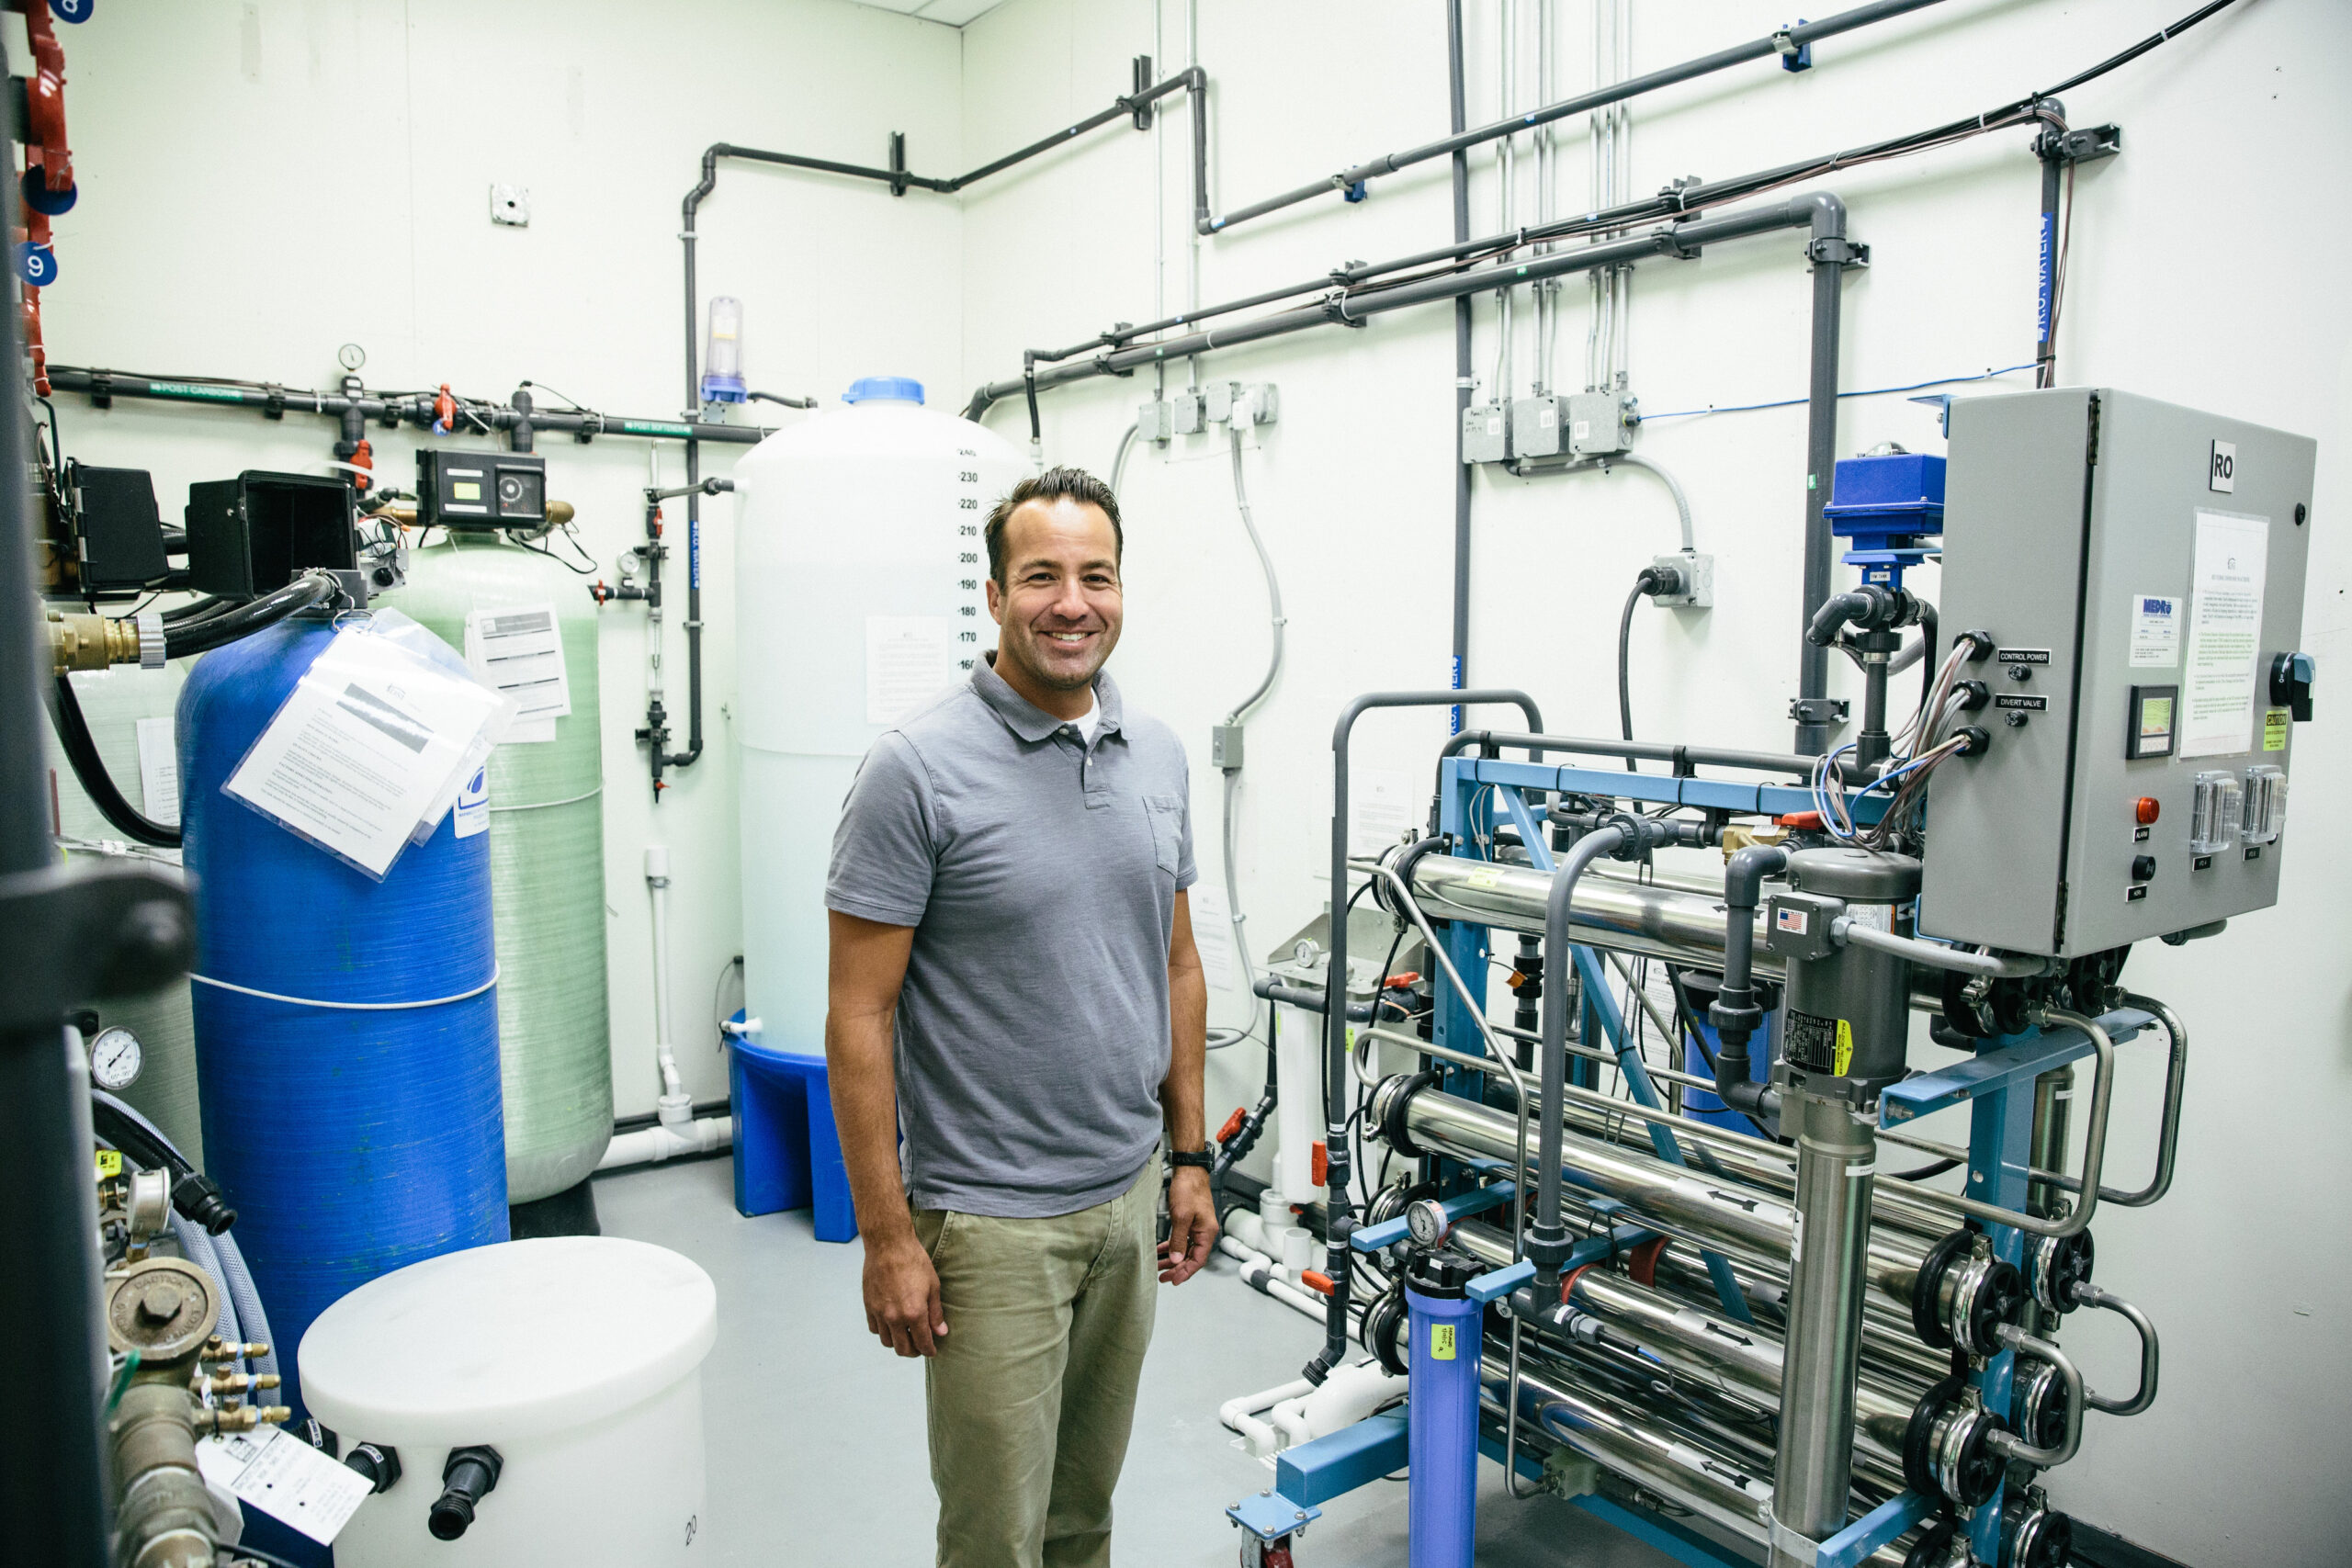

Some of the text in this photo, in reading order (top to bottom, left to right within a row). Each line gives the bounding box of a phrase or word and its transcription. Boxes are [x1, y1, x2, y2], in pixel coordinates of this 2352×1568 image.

[163, 383, 232, 397] POST CARBON
[2214, 453, 2233, 479] RO
[961, 471, 978, 482] 230
[960, 499, 978, 509] 220
[960, 525, 977, 536] 210
[960, 553, 978, 563] 200
[960, 580, 977, 590] 190
[960, 606, 976, 616] 180
[960, 632, 977, 642] 170
[2022, 699, 2041, 707] VALVE
[684, 1514, 697, 1548] 20
